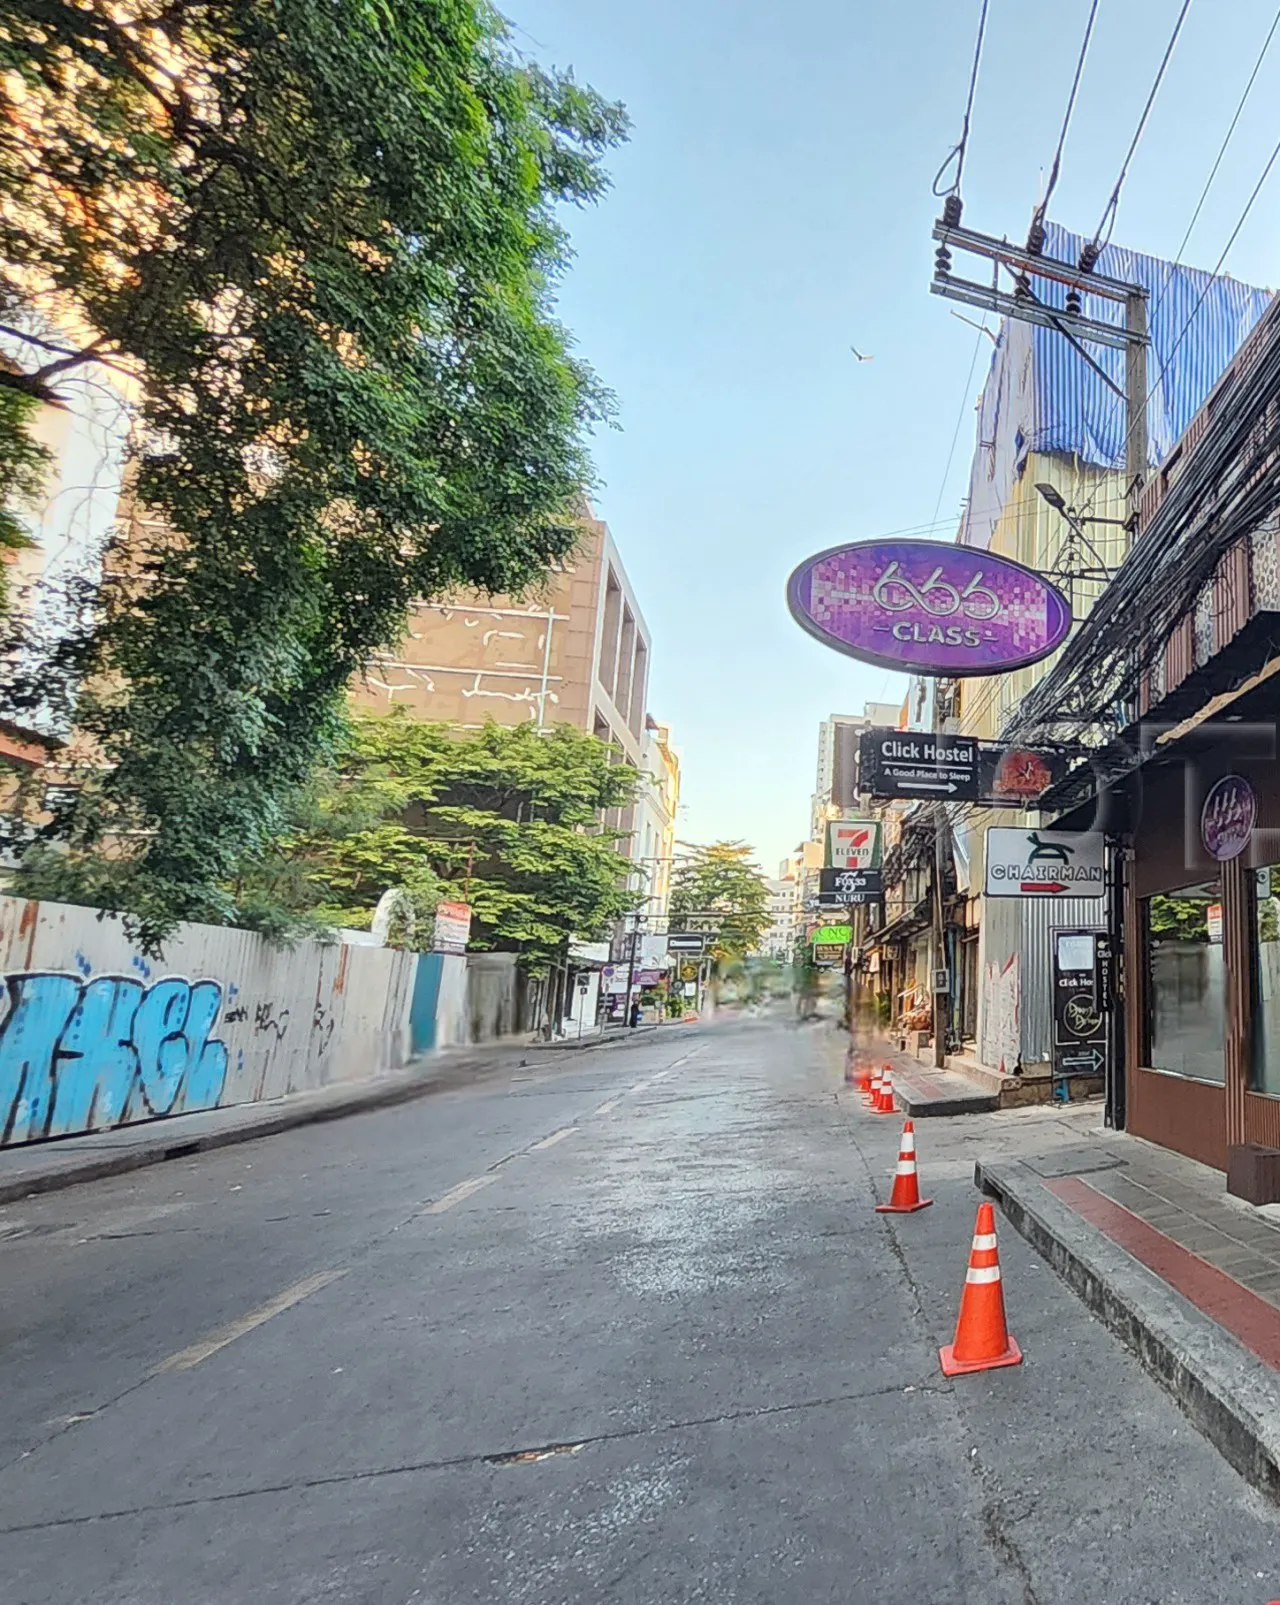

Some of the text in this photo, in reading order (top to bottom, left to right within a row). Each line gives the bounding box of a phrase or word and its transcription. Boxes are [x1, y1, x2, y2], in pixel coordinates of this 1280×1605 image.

[872, 561, 1000, 620] 666
[881, 741, 973, 763] Click Hostel
[884, 768, 971, 782] A Good Place to Sleep
[838, 829, 868, 867] 7
[990, 864, 1102, 881] CHAIRMAN
[835, 894, 865, 903] NURU
